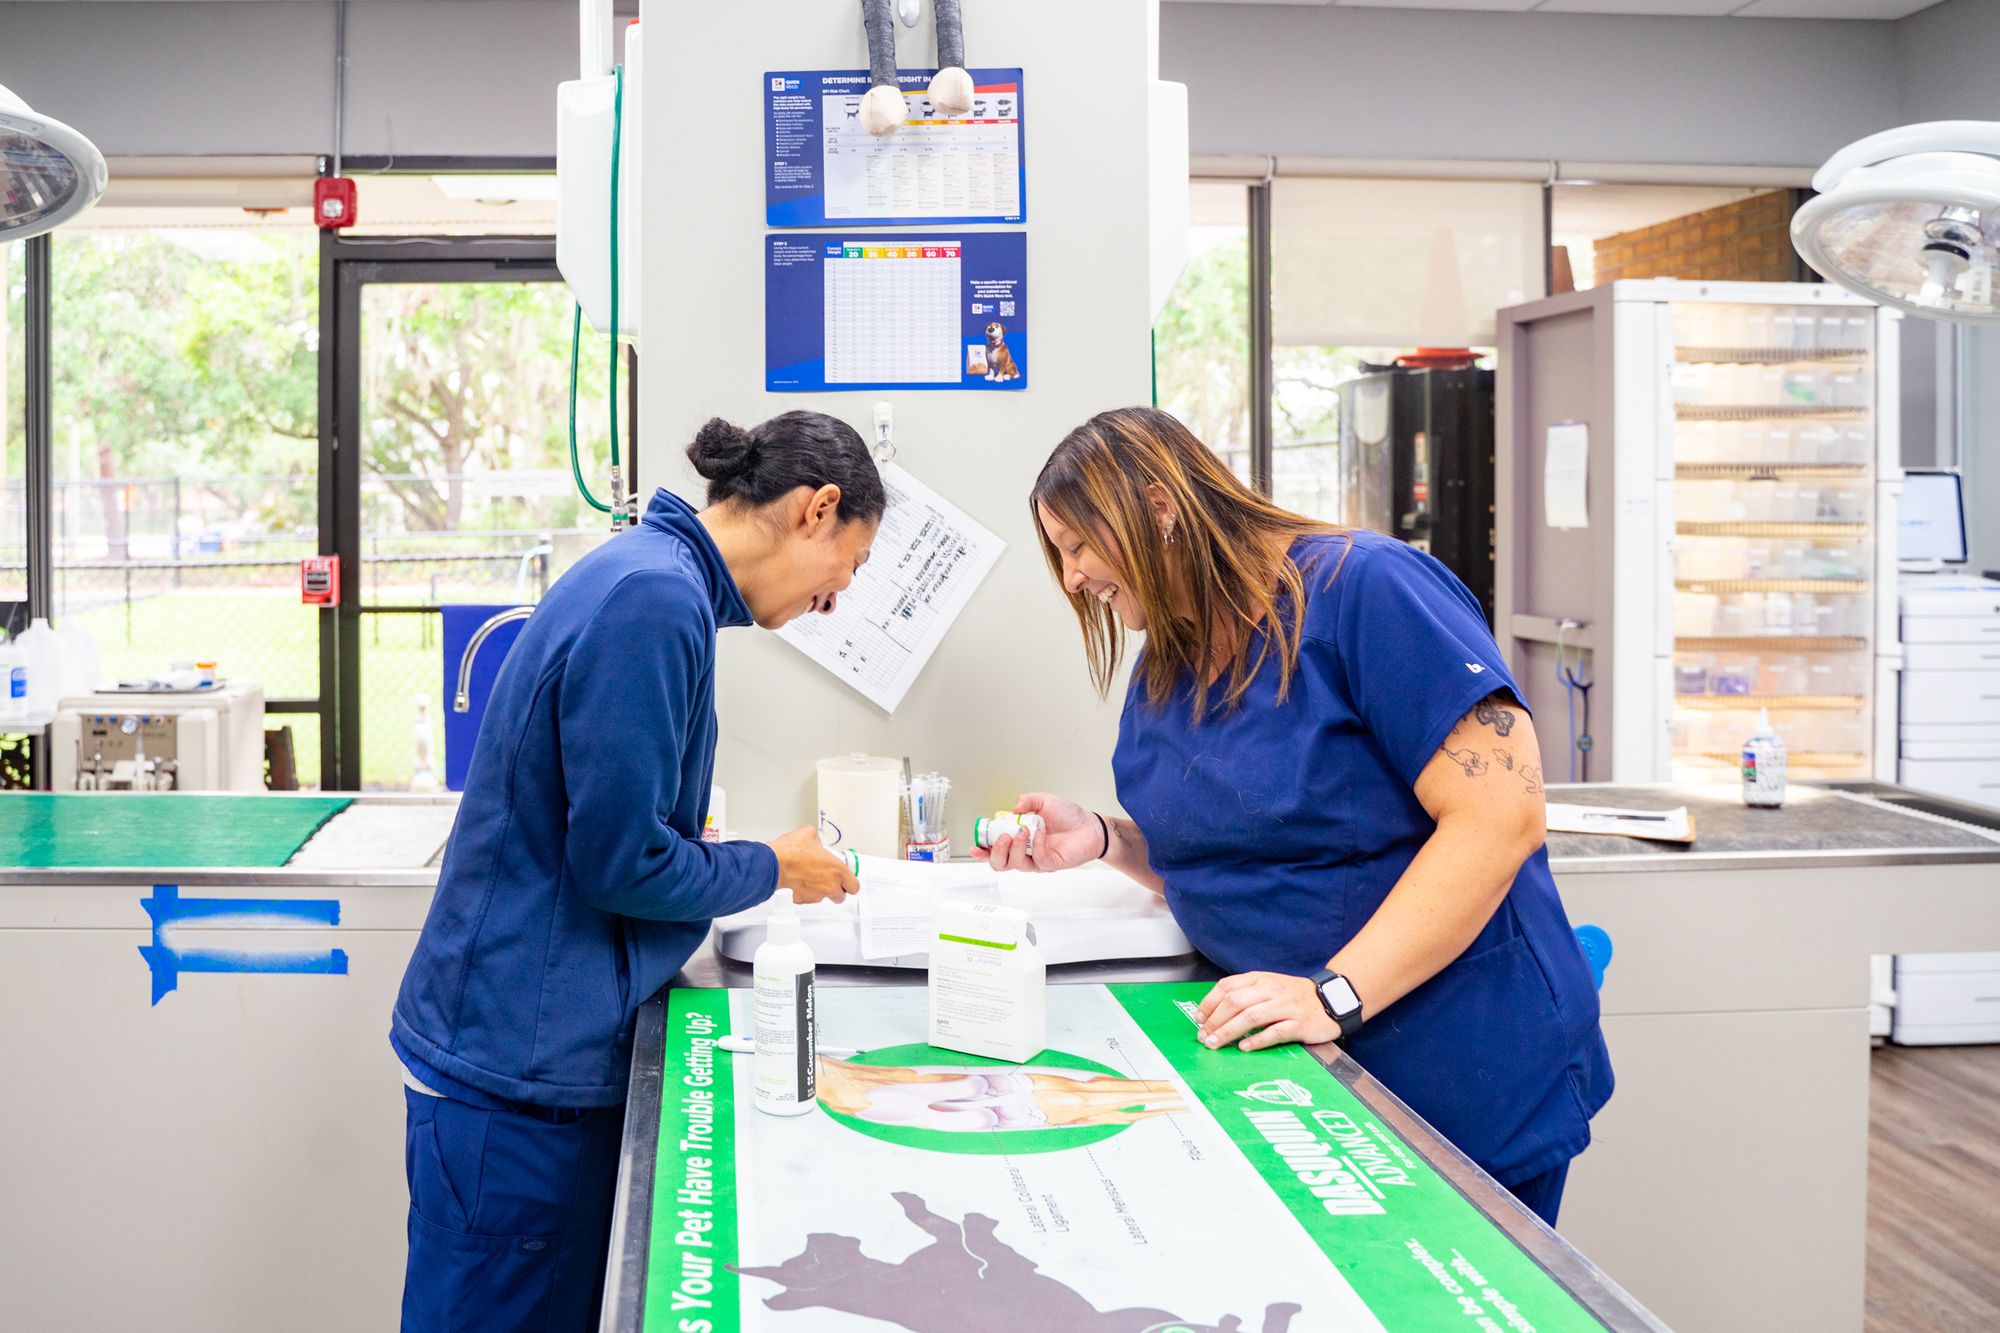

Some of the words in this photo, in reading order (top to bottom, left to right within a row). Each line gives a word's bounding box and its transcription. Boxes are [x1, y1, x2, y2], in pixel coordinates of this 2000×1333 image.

[304, 560, 331, 571] FIRE
[684, 1012, 718, 1035] Up?
[682, 1037, 718, 1087] Getting
[679, 1090, 714, 1151] Trouble
[1311, 1109, 1417, 1187] ADVANCED
[677, 1157, 714, 1206] Have
[1004, 1165, 1033, 1202] Collateral
[1100, 1179, 1130, 1214] Meniscus
[674, 1209, 714, 1248] Pet
[1021, 1203, 1047, 1233] Lateral
[1041, 1193, 1070, 1232] Ligament
[1117, 1214, 1148, 1245] Lateral
[671, 1253, 714, 1311] Your
[1403, 1236, 1465, 1295] complex.
[1455, 1295, 1485, 1314] be
[1480, 1285, 1539, 1333] simple
